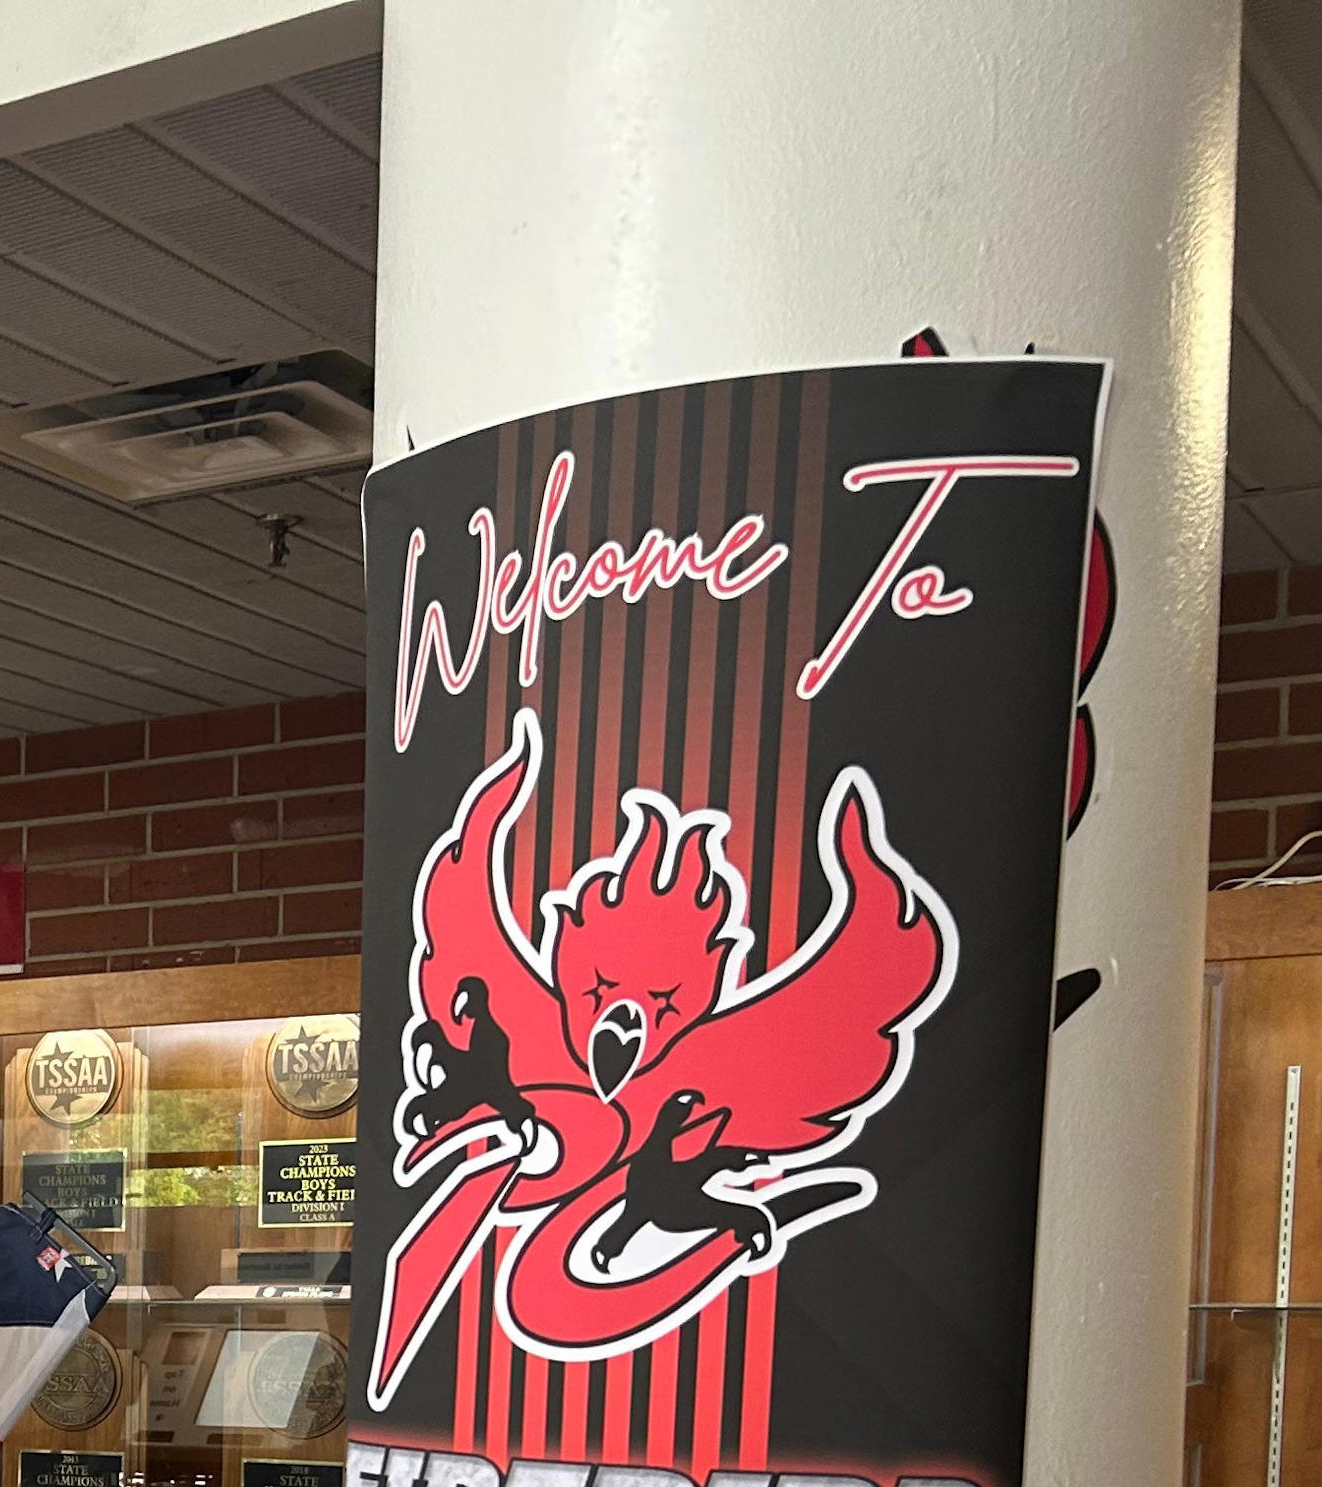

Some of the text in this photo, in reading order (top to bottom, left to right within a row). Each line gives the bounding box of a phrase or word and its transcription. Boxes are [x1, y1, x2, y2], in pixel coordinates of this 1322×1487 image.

[392, 450, 1081, 753] Welcome To
[278, 1040, 359, 1075] TSSAA
[35, 1057, 109, 1089] TSSAA
[298, 1154, 340, 1167] STATE
[279, 1165, 357, 1180] CHAMPIONS
[300, 1178, 336, 1191] BOYS
[267, 1189, 356, 1203] TRACK & FIE
[291, 1202, 338, 1213] DIVISION
[299, 1213, 328, 1222] CLASS
[53, 1464, 89, 1476] STATE
[36, 1474, 105, 1487] CHAMPIONS
[279, 1475, 319, 1487] STATE
